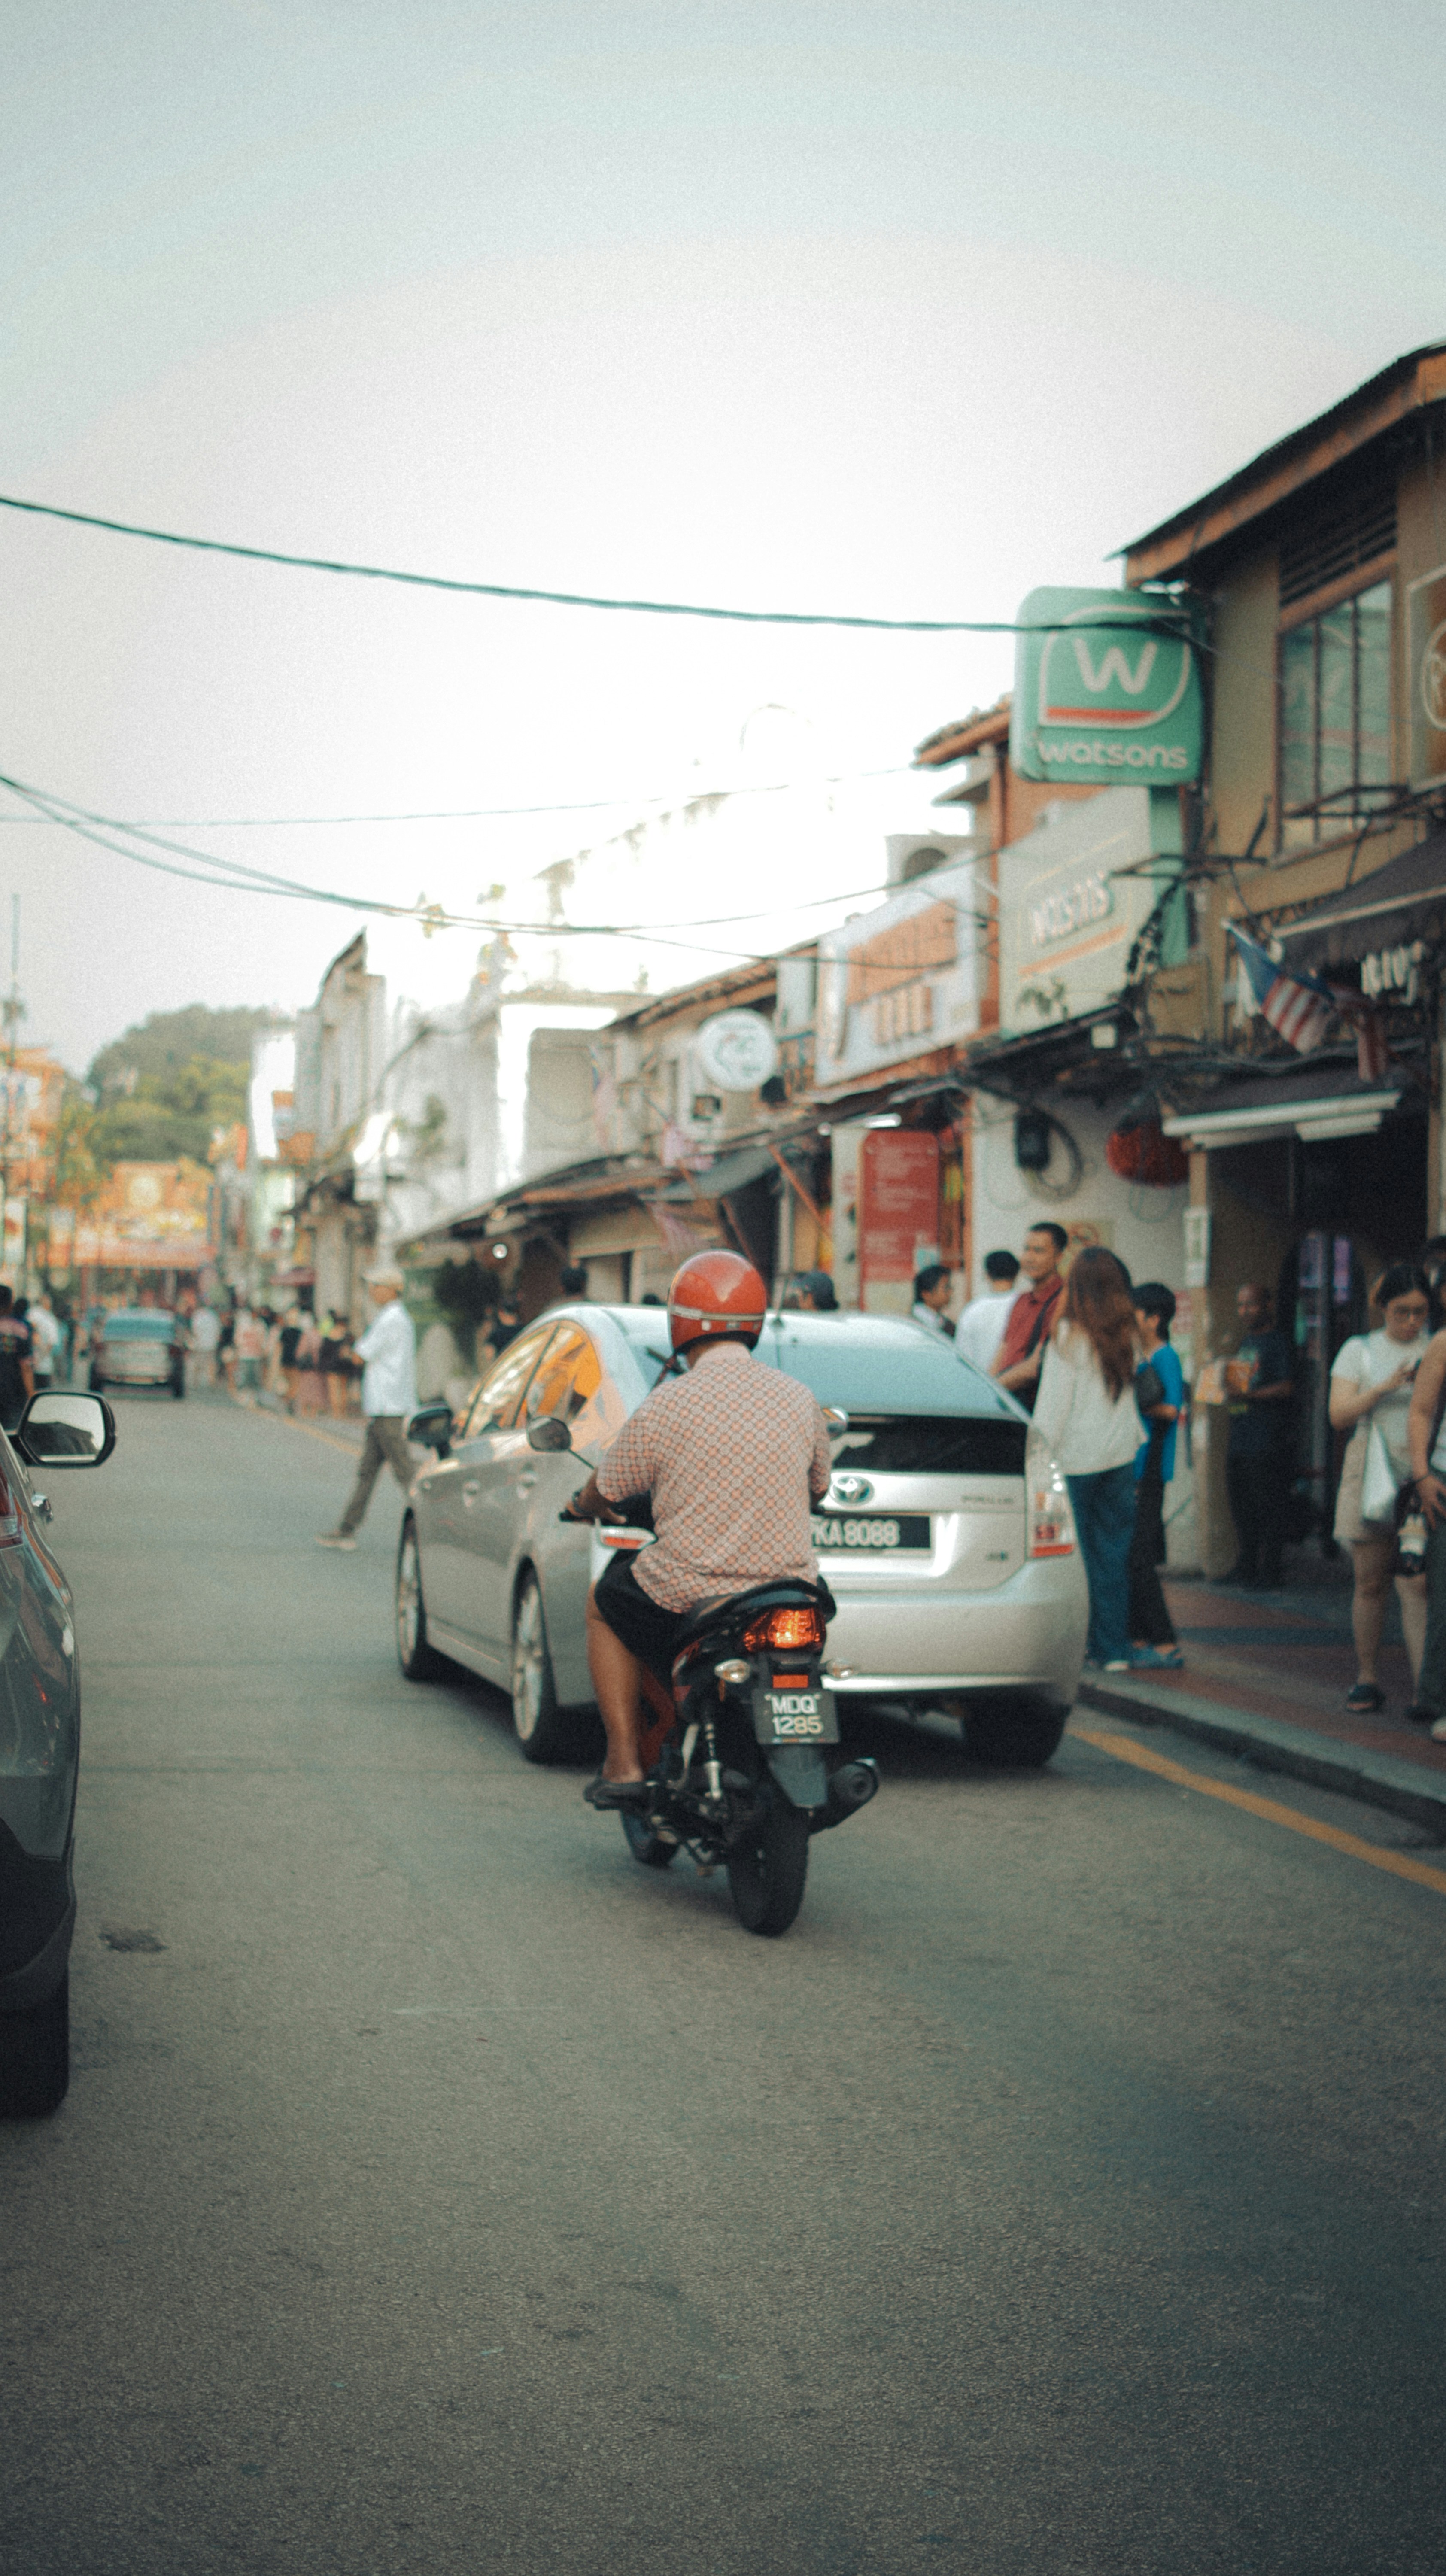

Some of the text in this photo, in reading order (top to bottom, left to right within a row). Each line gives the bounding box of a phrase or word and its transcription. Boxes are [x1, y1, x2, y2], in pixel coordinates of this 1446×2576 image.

[1073, 638, 1157, 694] W
[1038, 740, 1188, 769] watsons
[772, 1695, 817, 1714] MDQ
[772, 1715, 823, 1734] 1285
